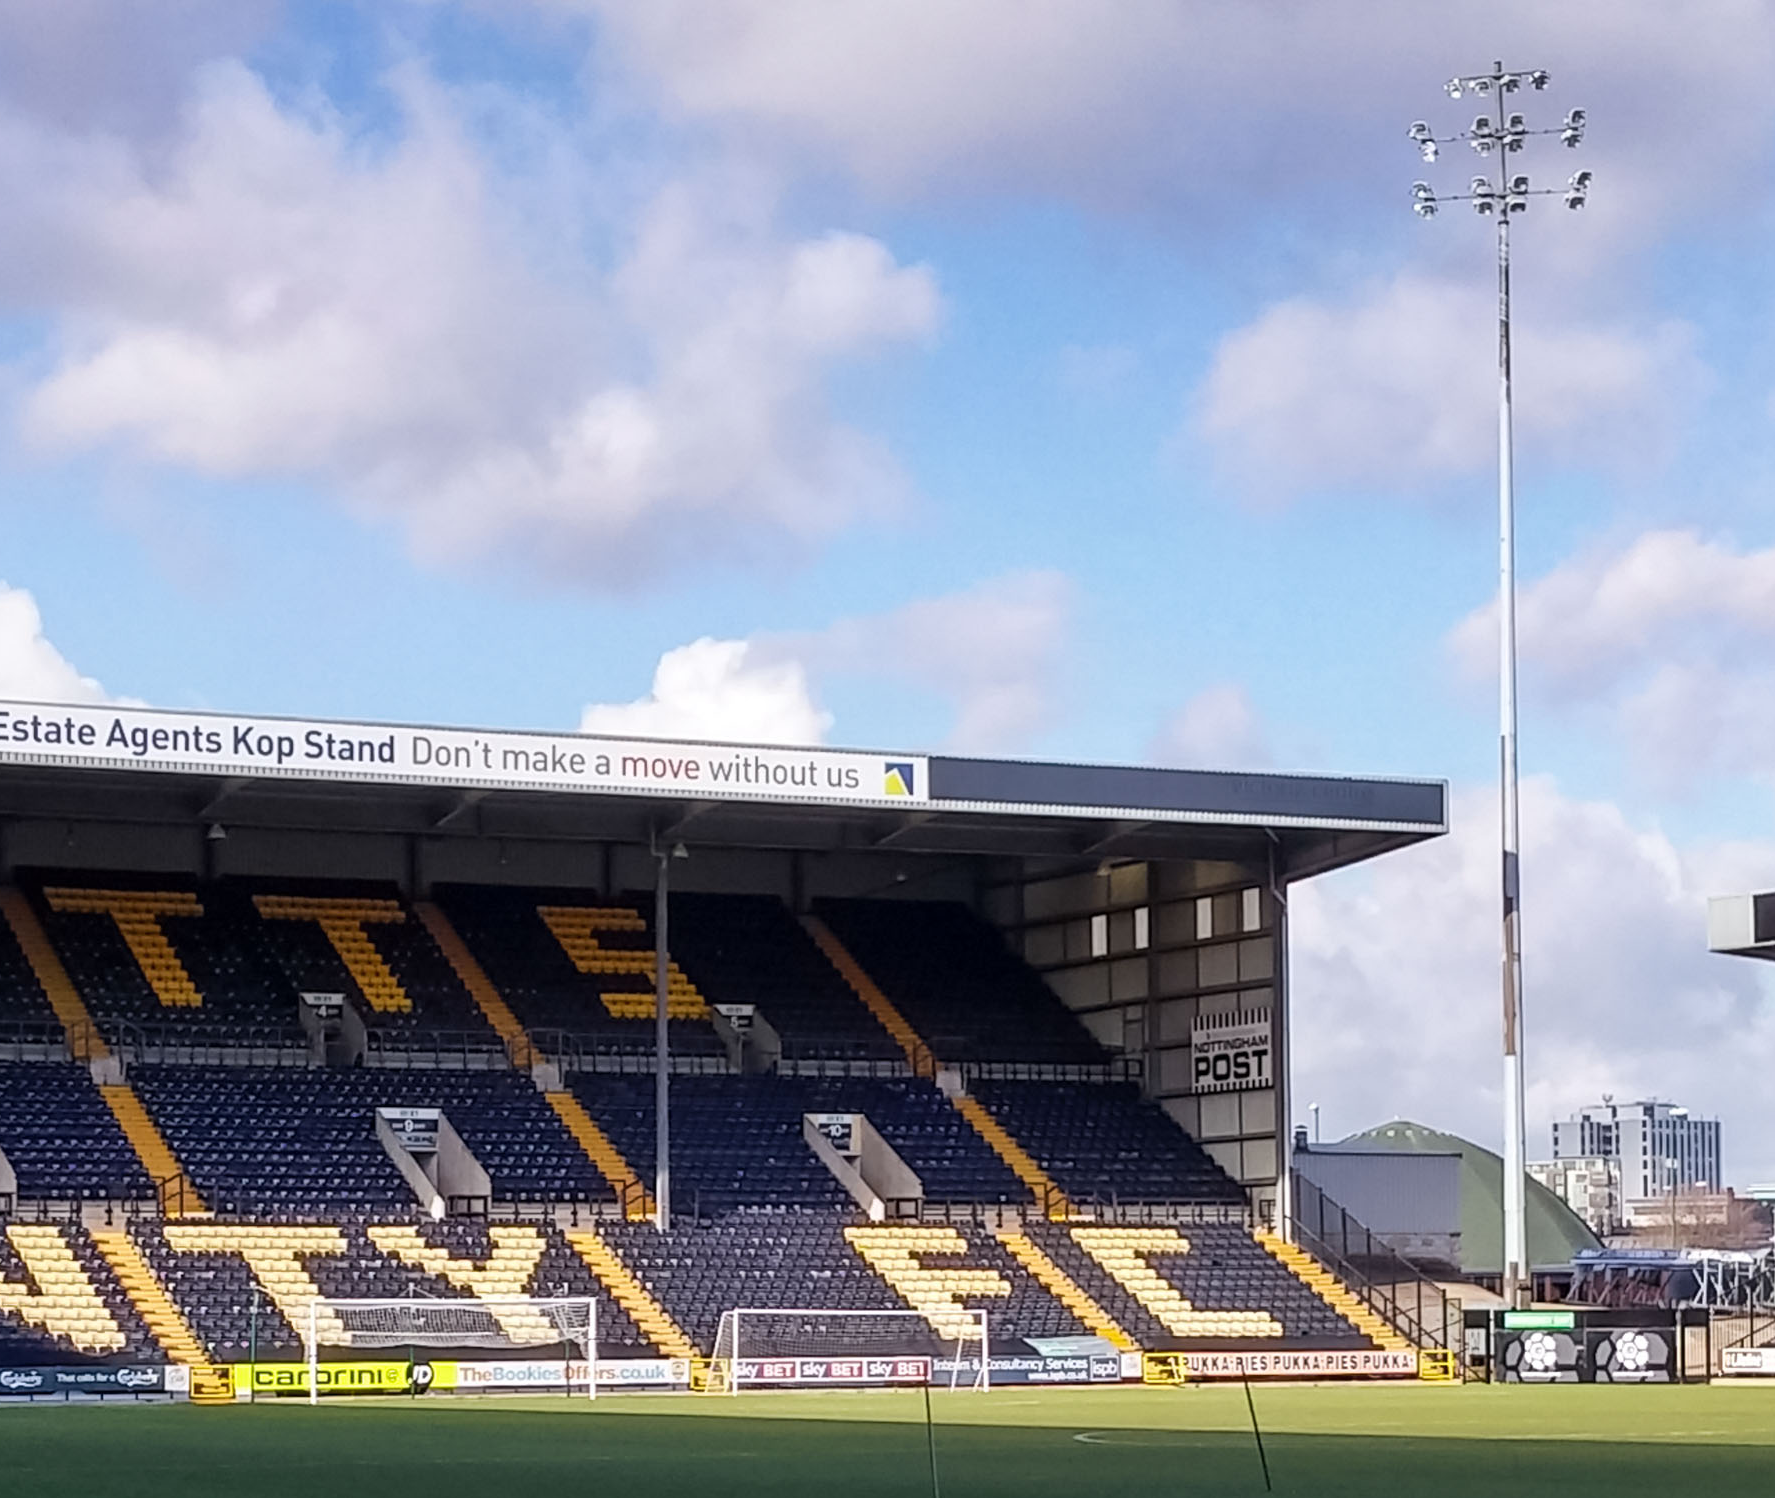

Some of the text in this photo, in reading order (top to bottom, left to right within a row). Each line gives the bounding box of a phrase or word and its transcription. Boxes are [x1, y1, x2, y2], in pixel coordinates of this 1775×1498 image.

[106, 717, 223, 757] Agents
[232, 725, 295, 765] Kop
[305, 730, 395, 765] Stand
[412, 735, 493, 771] Don't
[502, 743, 587, 775] make
[595, 754, 611, 777] a
[621, 755, 701, 782] move
[710, 754, 819, 787] without
[826, 766, 861, 790] us
[1194, 1034, 1269, 1054] NOTTINGHAM
[1194, 1049, 1268, 1085] POST
[828, 1124, 843, 1137] 10
[848, 1225, 1282, 1343] FC
[460, 1364, 666, 1382] TheBookiesOffrs.co.uk
[763, 1362, 794, 1377] BET
[801, 1361, 826, 1378] sky
[831, 1362, 861, 1376] BET
[868, 1361, 894, 1377] sky
[1044, 1357, 1088, 1370] Services
